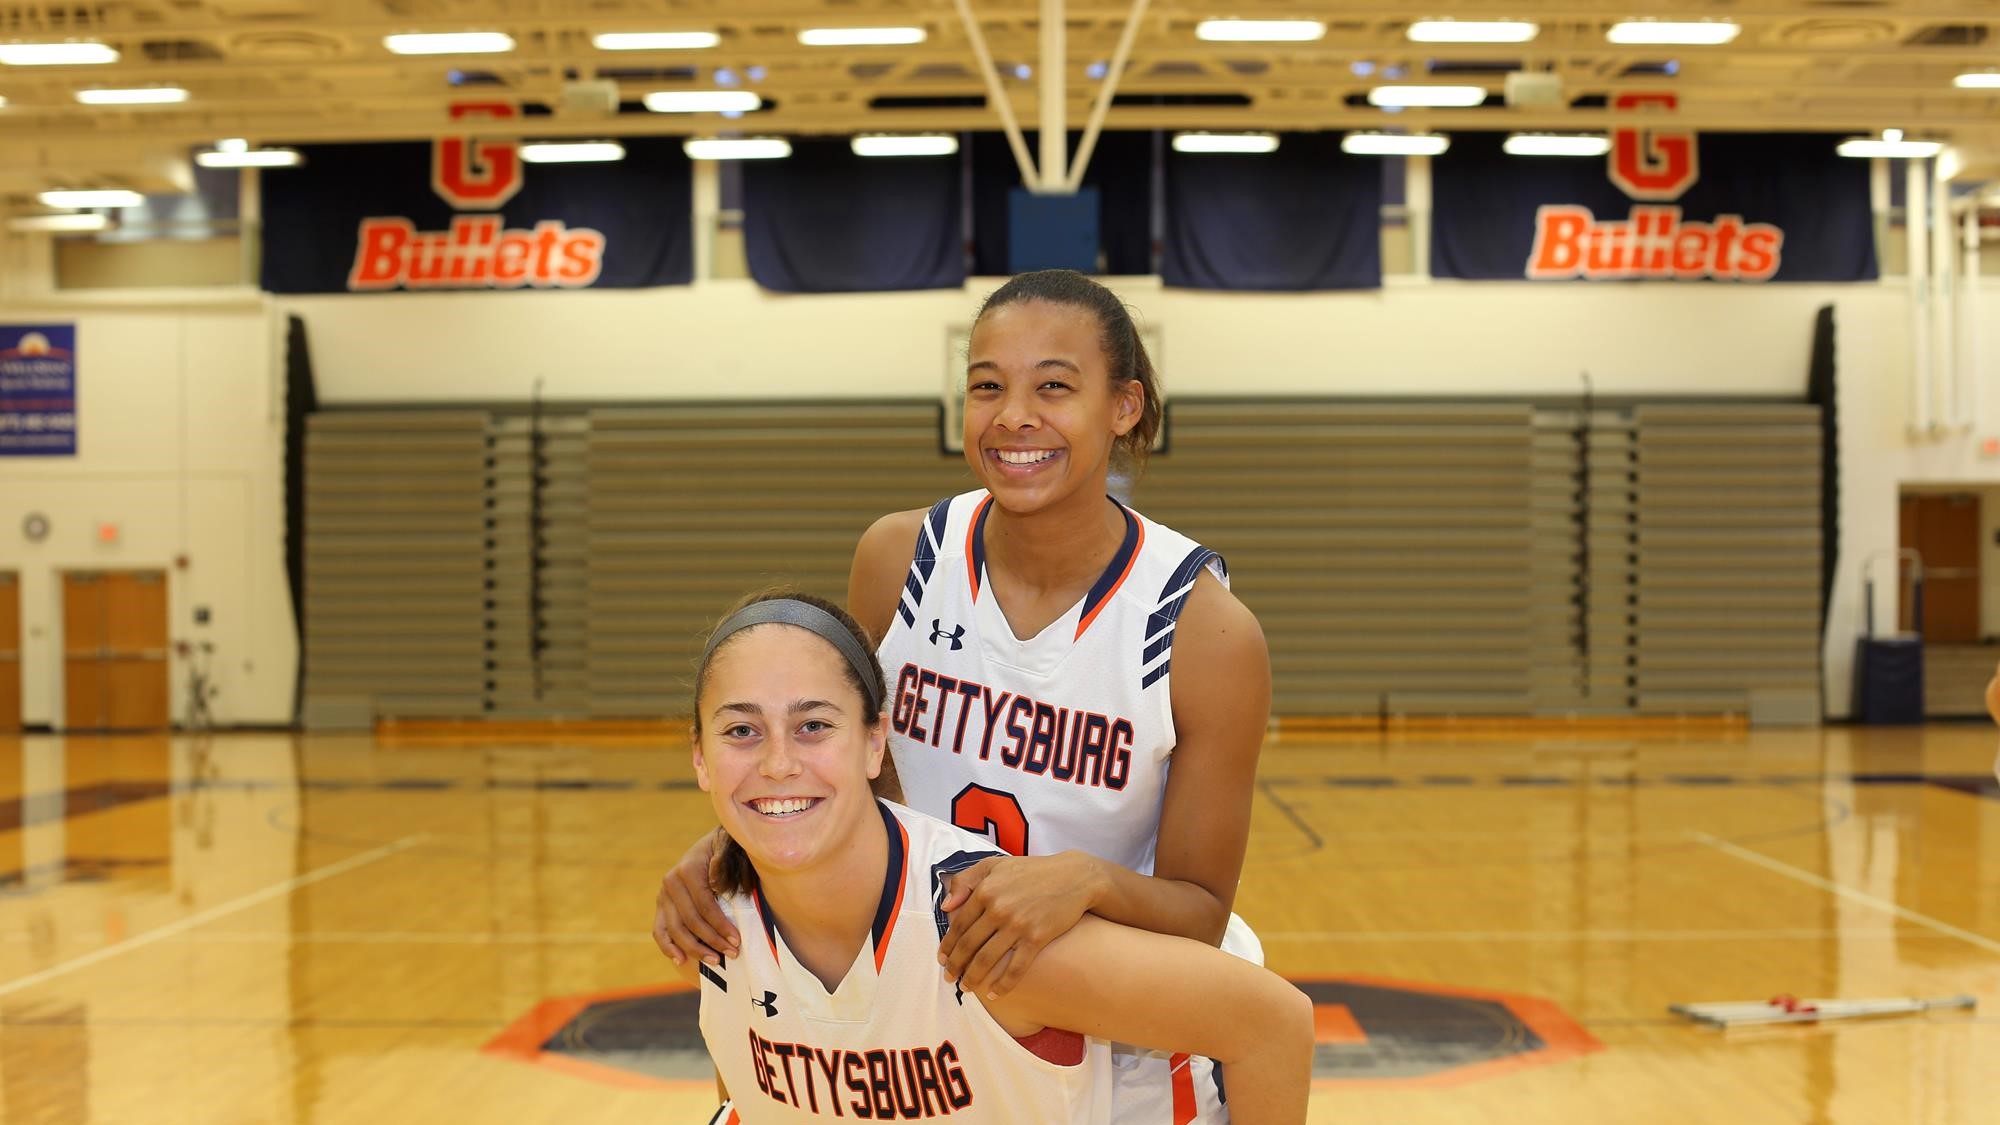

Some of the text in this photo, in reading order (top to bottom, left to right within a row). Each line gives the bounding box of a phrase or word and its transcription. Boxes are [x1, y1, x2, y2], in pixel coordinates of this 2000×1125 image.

[433, 100, 522, 209] G
[1607, 90, 1698, 199] G
[349, 216, 605, 290] Bullets
[1526, 204, 1784, 280] Bullets
[892, 662, 1134, 791] GETTYSBURG
[749, 1026, 973, 1120] GETTYSBURG
